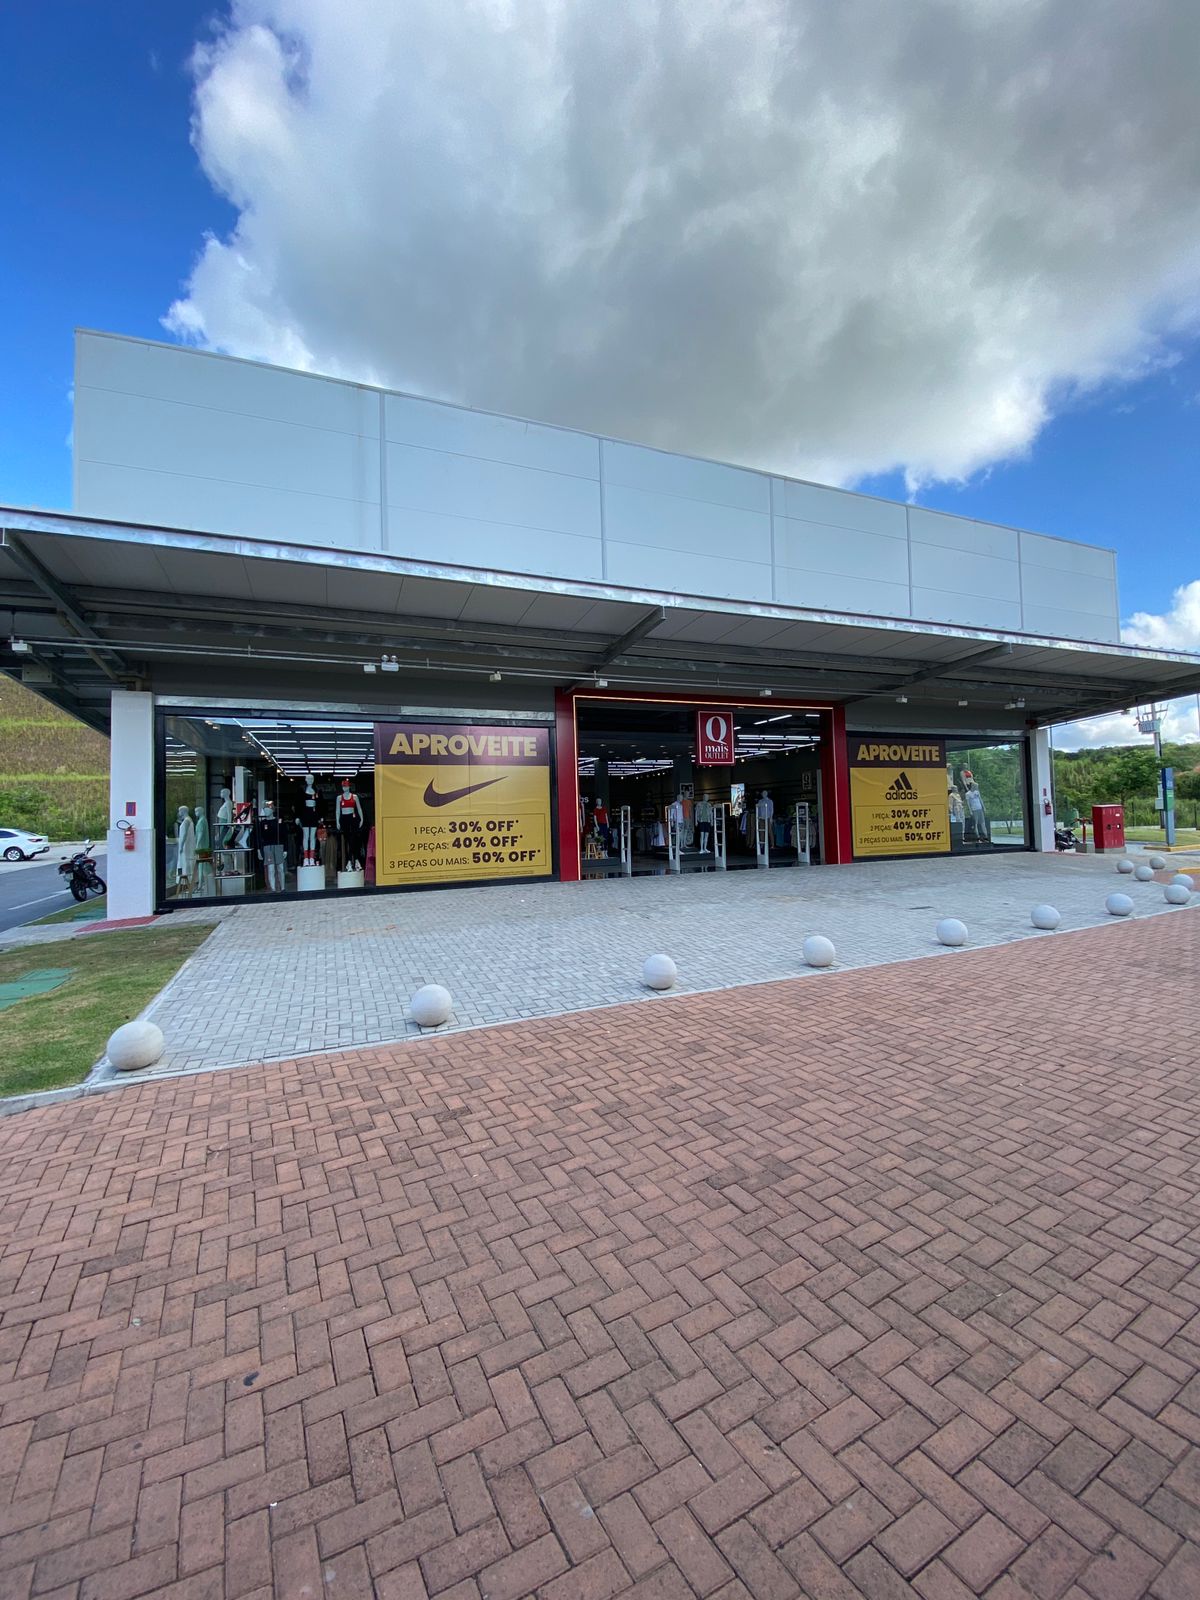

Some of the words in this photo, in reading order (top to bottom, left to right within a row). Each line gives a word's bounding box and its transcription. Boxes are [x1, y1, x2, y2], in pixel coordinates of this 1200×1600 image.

[706, 716, 727, 745] Q
[389, 733, 538, 757] APROVEITE
[705, 744, 729, 752] mais
[857, 744, 940, 761] APROVEITE
[885, 790, 918, 801] adidas
[891, 809, 910, 818] 30%
[414, 826, 418, 835] 1
[420, 826, 446, 836] PEÇA:
[448, 820, 482, 833] 30%
[893, 821, 913, 830] 40%
[410, 843, 416, 851] 2
[417, 842, 449, 853] PEÇAS:
[452, 836, 486, 849] 40%
[904, 832, 924, 841] 50%
[389, 860, 395, 868] 3
[397, 858, 428, 870] PEÇAS
[429, 858, 444, 867] OU
[445, 856, 470, 866] MAIS:
[472, 851, 505, 864] 50%
